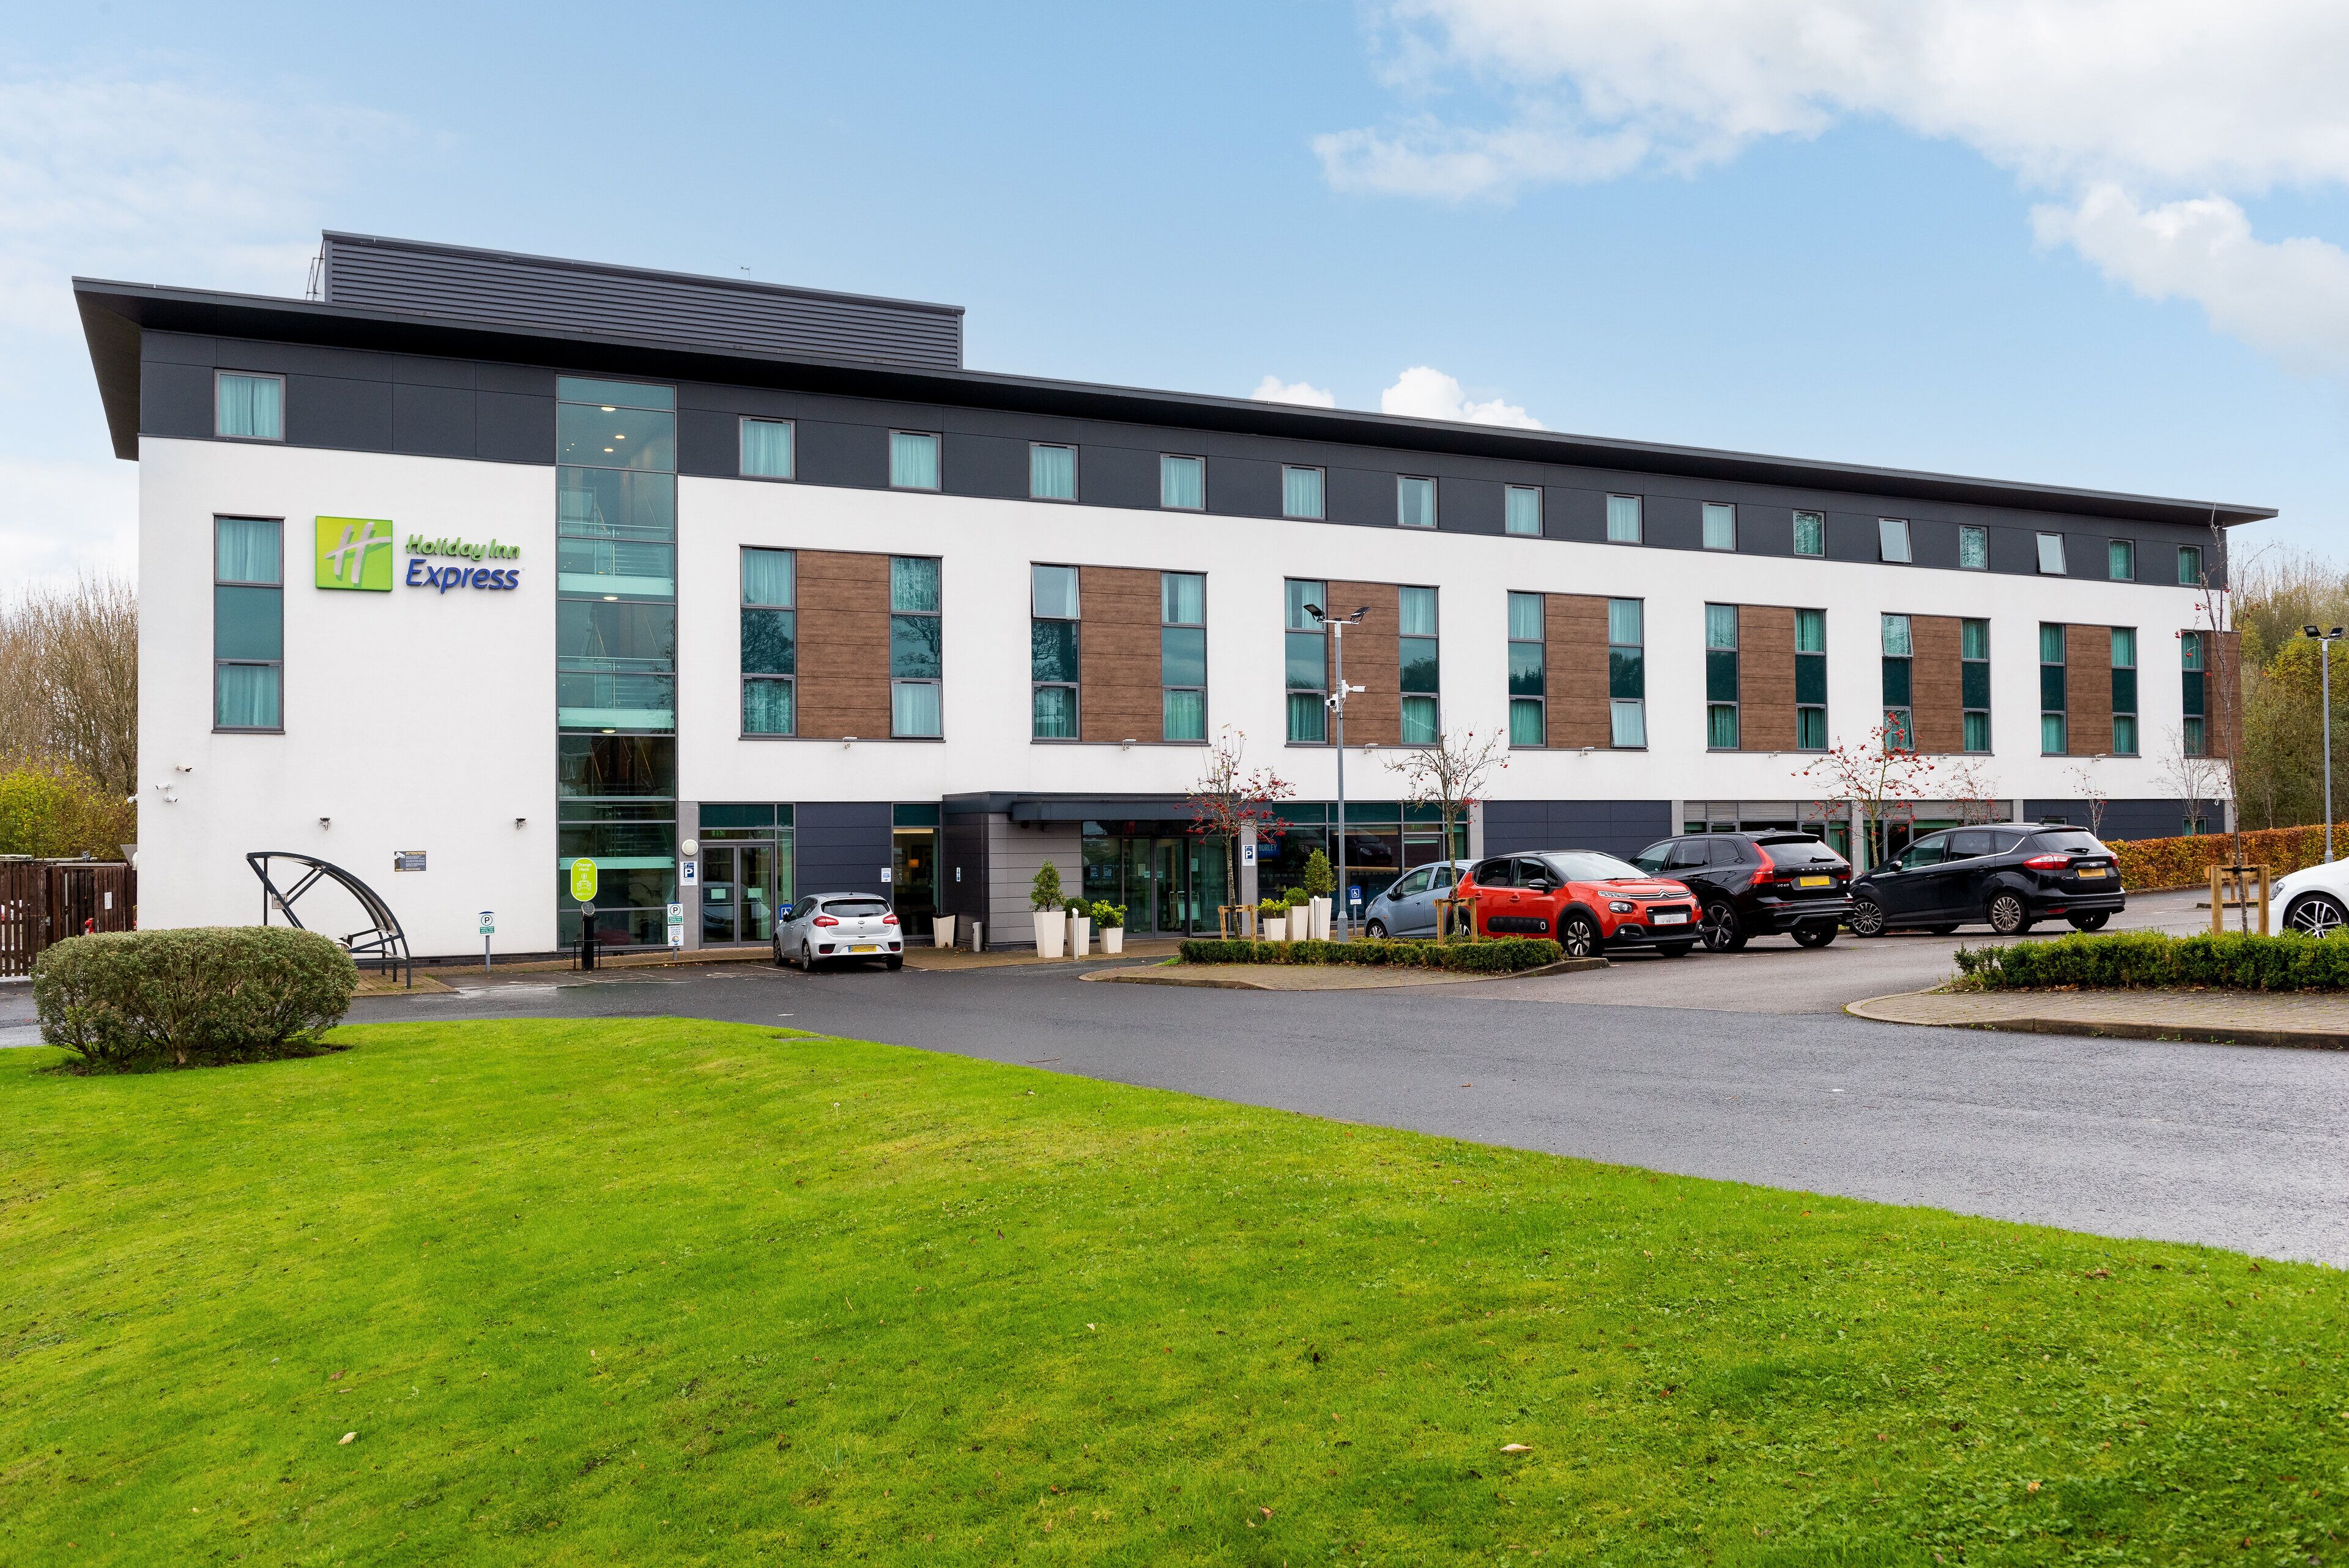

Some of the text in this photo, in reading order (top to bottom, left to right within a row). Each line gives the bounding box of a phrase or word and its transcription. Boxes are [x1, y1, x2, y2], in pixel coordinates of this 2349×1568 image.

[406, 534, 520, 561] Holiday Inn
[406, 559, 520, 594] Express
[1245, 850, 1252, 859] P
[685, 869, 693, 877] P
